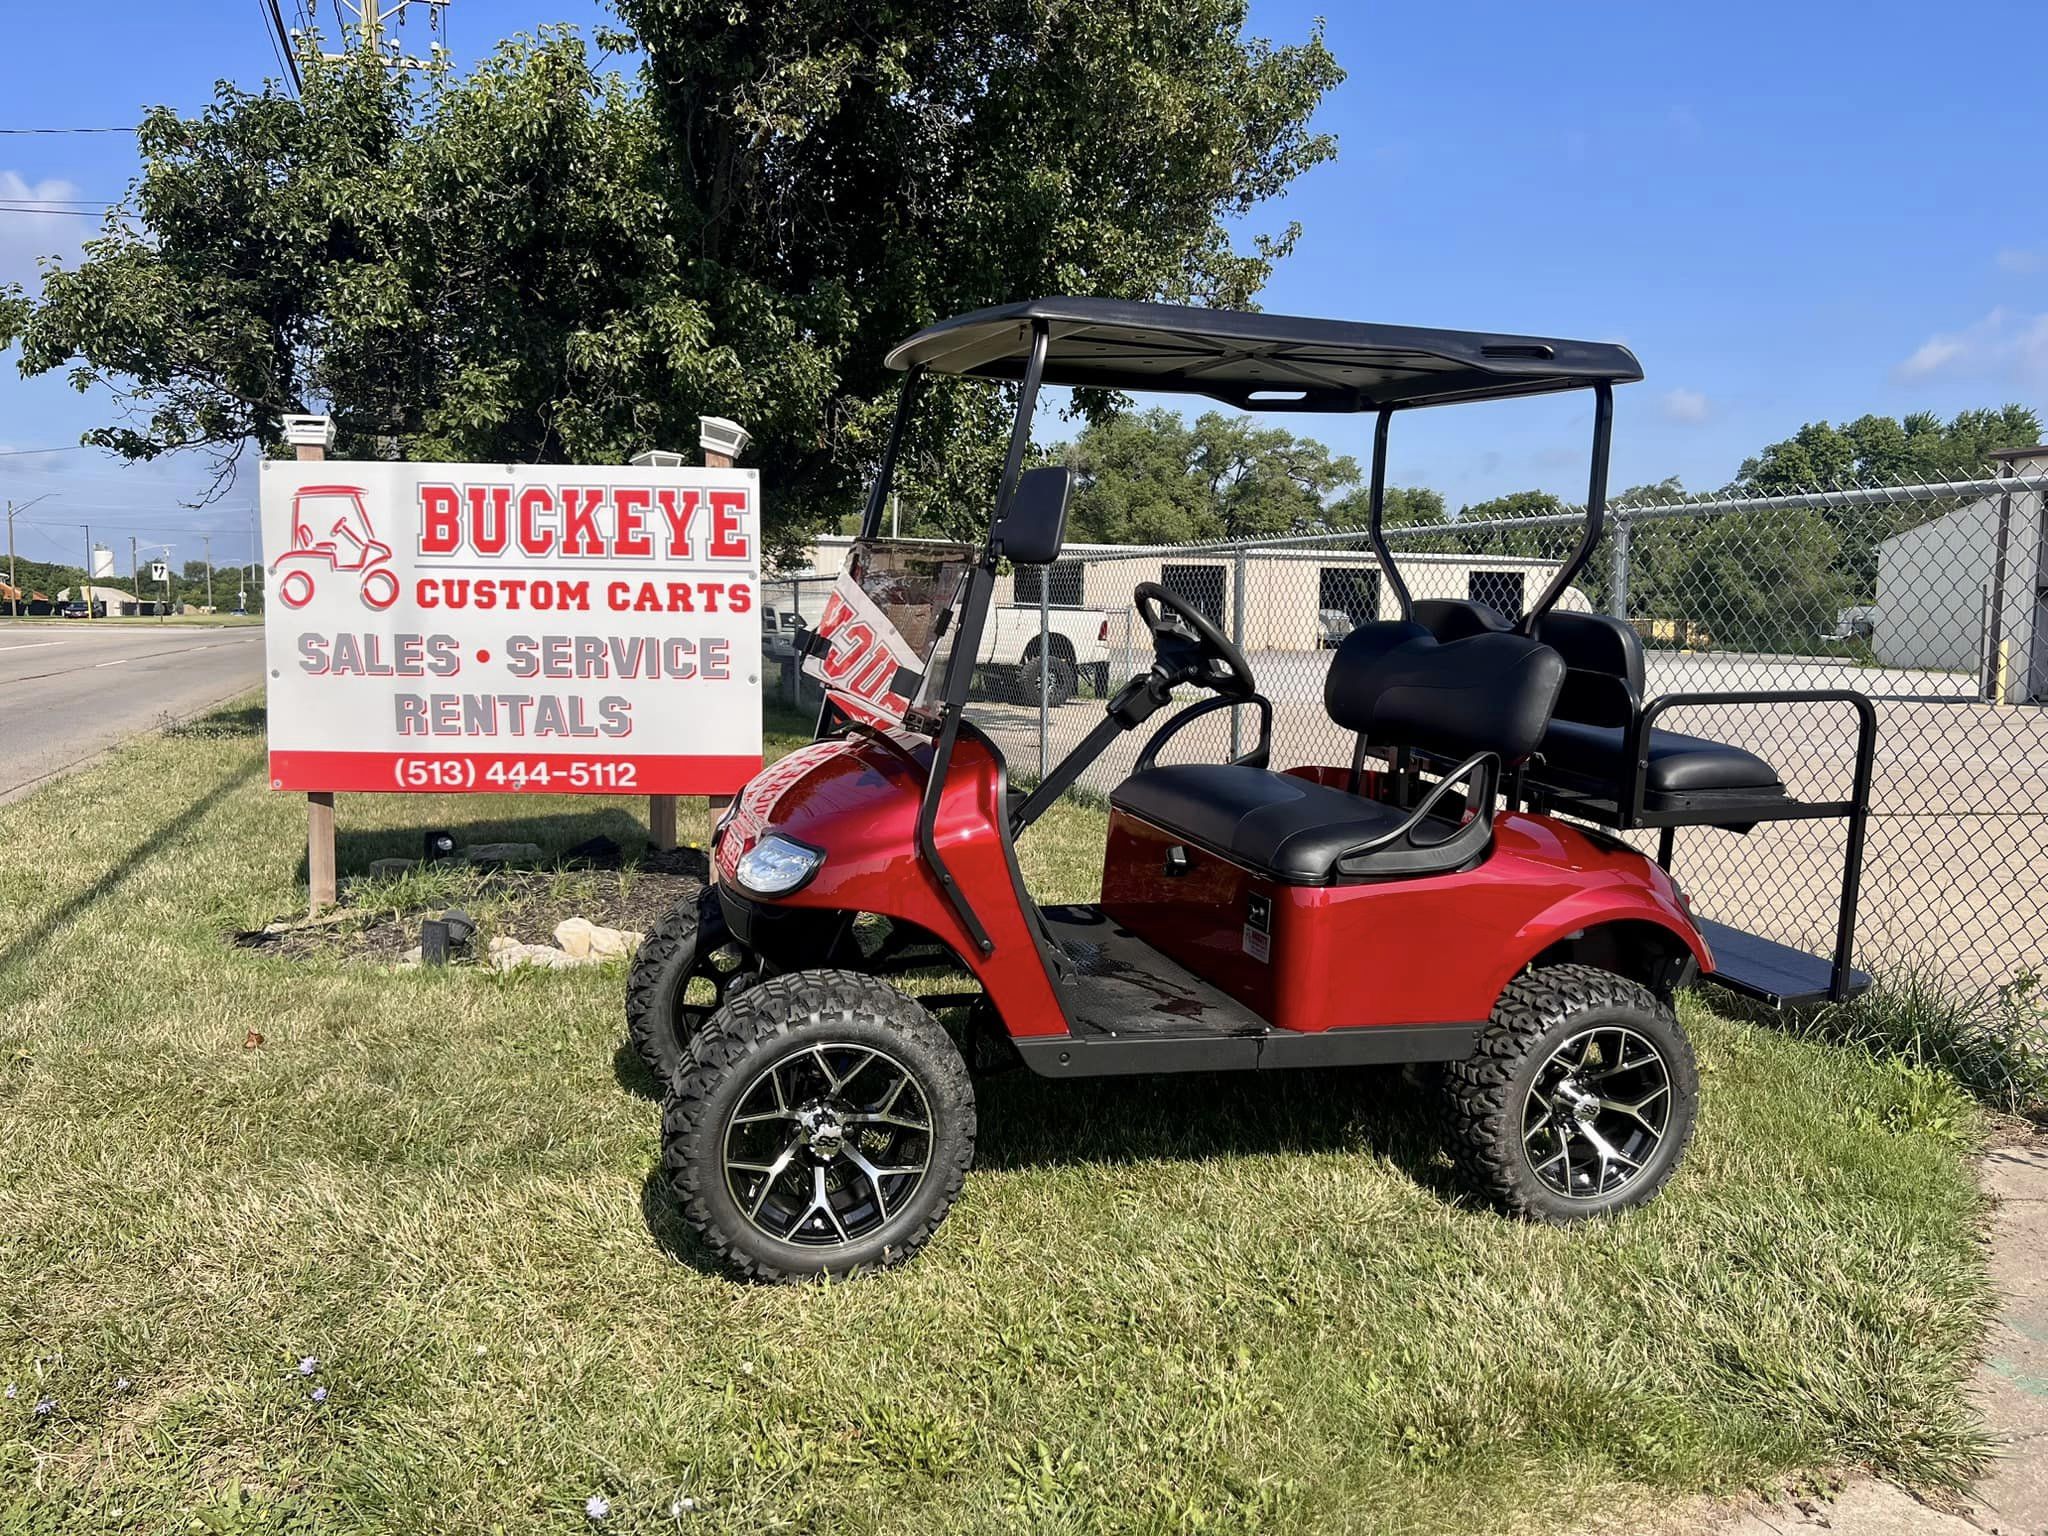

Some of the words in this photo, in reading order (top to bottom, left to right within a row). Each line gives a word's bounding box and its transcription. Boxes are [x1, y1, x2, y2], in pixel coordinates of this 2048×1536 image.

[417, 482, 751, 562] BUCKEYE
[416, 578, 590, 610] CUSTOM
[607, 581, 752, 613] CARTS
[297, 633, 460, 676] SALES
[505, 635, 730, 680] SERVICE
[394, 693, 632, 737] RENTALS
[394, 758, 476, 788] (513)
[485, 760, 637, 788] 444-5112
